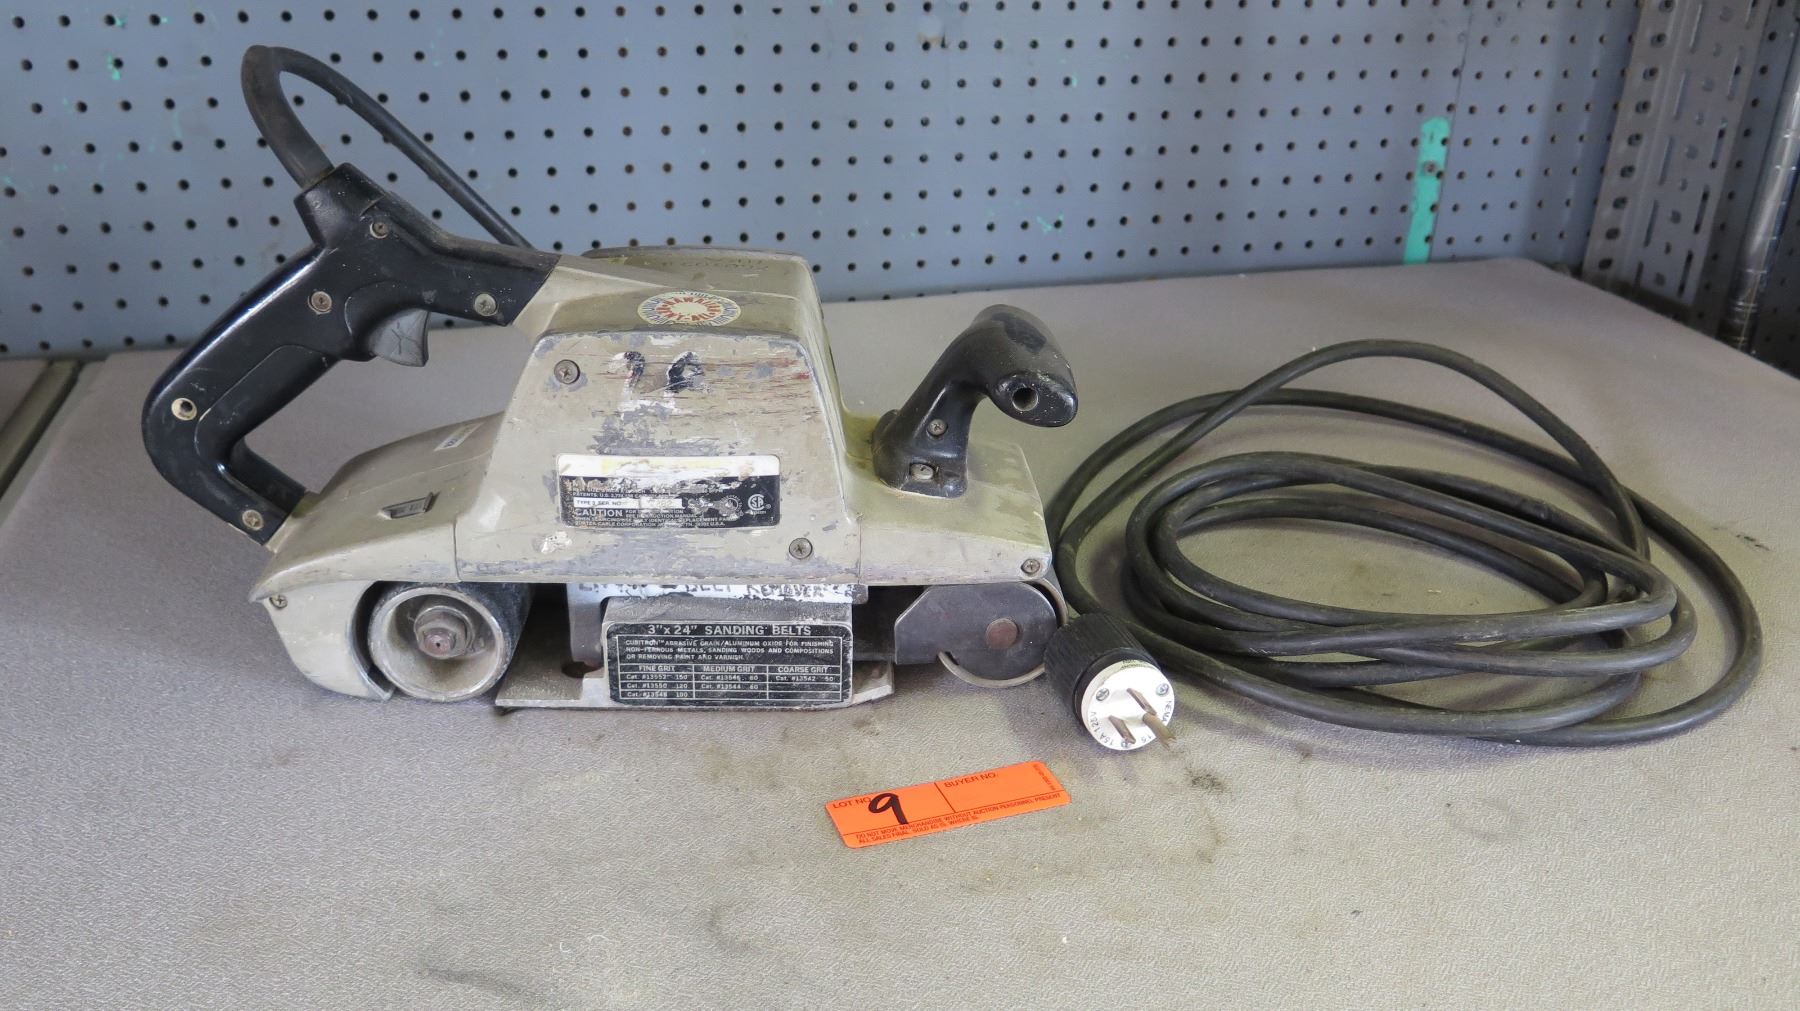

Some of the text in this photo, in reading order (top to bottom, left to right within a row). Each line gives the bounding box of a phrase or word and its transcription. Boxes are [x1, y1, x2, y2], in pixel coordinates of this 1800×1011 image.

[574, 508, 623, 517] CAUTION
[704, 625, 764, 635] SANDING
[772, 625, 812, 636] BELTS
[944, 776, 979, 788] BUYER
[868, 793, 908, 824] 9
[973, 806, 998, 815] AUCTION
